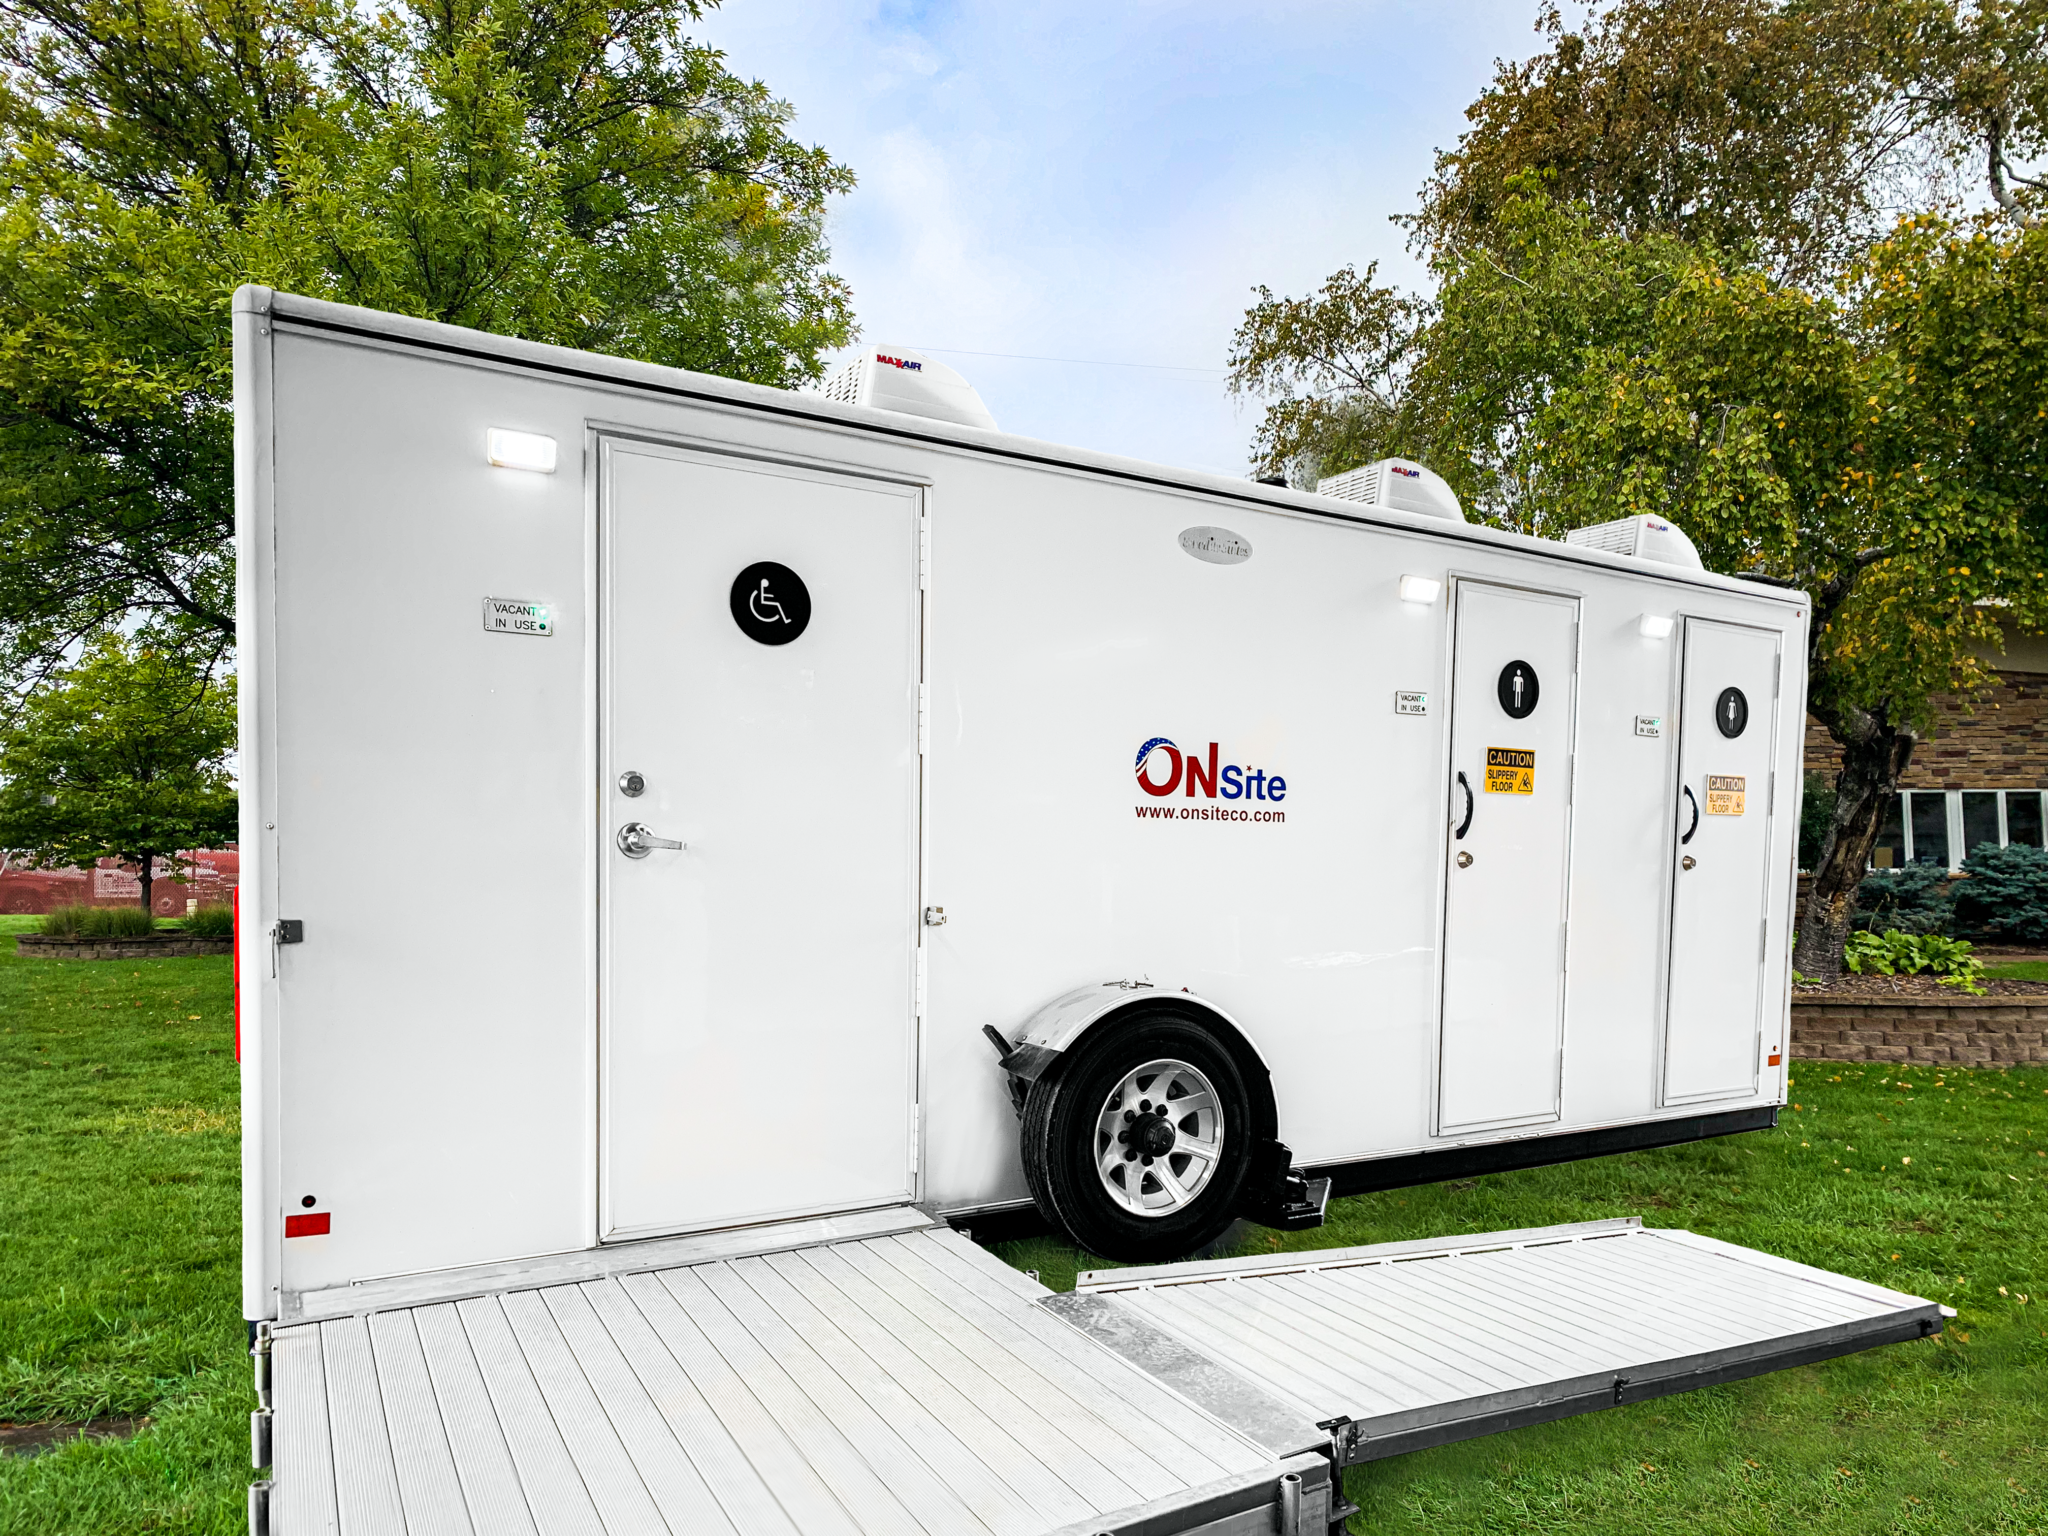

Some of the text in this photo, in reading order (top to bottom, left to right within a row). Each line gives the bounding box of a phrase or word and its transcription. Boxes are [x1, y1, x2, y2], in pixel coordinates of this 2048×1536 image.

[493, 603, 537, 616] VACANT
[495, 618, 537, 631] IN USE
[1400, 694, 1421, 702] VACANT
[1410, 704, 1421, 712] USE
[1489, 750, 1533, 766] CAUTION
[1487, 769, 1518, 780] SLIPPERY
[1491, 781, 1513, 791] FLOOR
[1710, 777, 1744, 791] CAUTION
[1709, 793, 1733, 803] SLIPPERY
[1712, 804, 1730, 813] FLOOR
[1135, 806, 1285, 823] www.onsiteco.com
